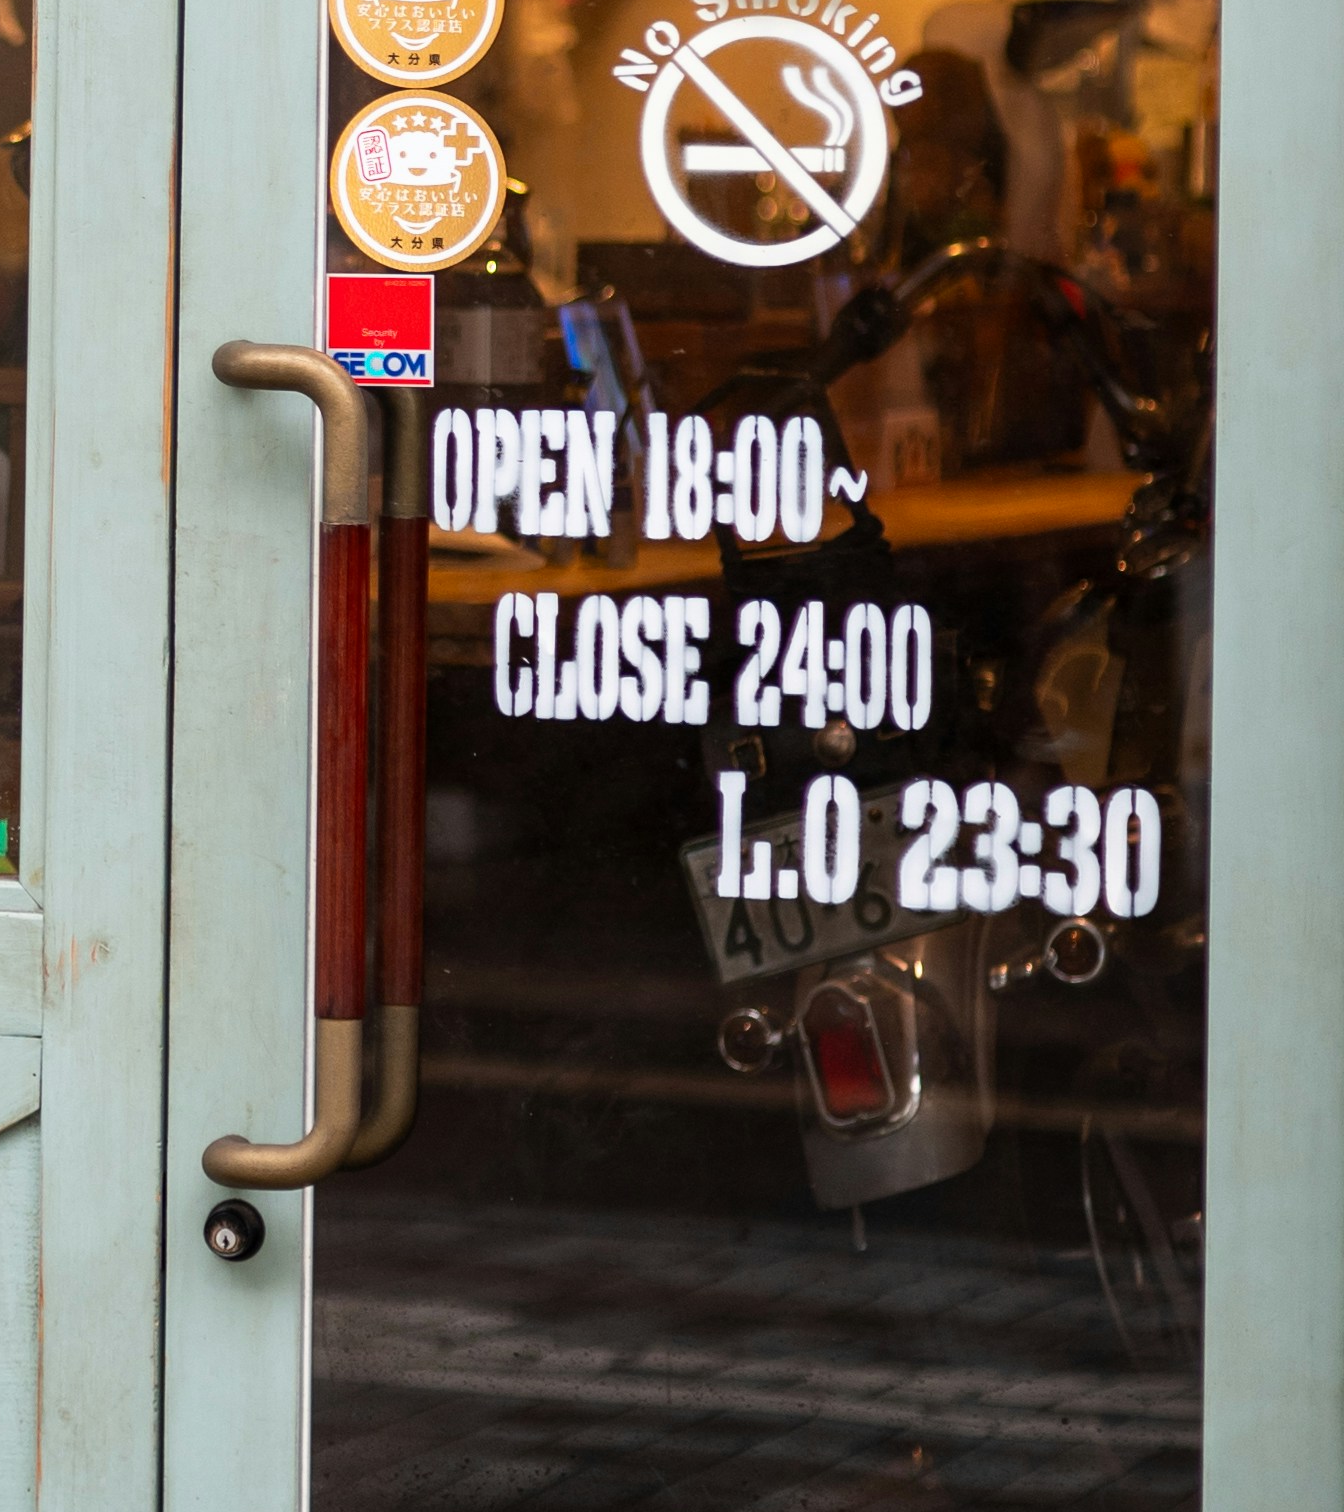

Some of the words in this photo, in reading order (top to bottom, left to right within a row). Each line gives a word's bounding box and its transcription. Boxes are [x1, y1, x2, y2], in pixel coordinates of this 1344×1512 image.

[356, 4, 475, 20] 安心はおいしい
[388, 52, 441, 66] 大分県
[612, 21, 681, 92] No
[359, 187, 478, 203] 安心はおいしい
[391, 237, 444, 250] 大分県
[362, 328, 398, 339] Security
[374, 338, 385, 348] by
[333, 352, 425, 377] SECOM
[432, 409, 616, 539] OPEN
[495, 592, 711, 726] CLOSE
[736, 599, 934, 731] 24:00
[717, 771, 861, 905] L.O
[899, 779, 1162, 918] 23:30
